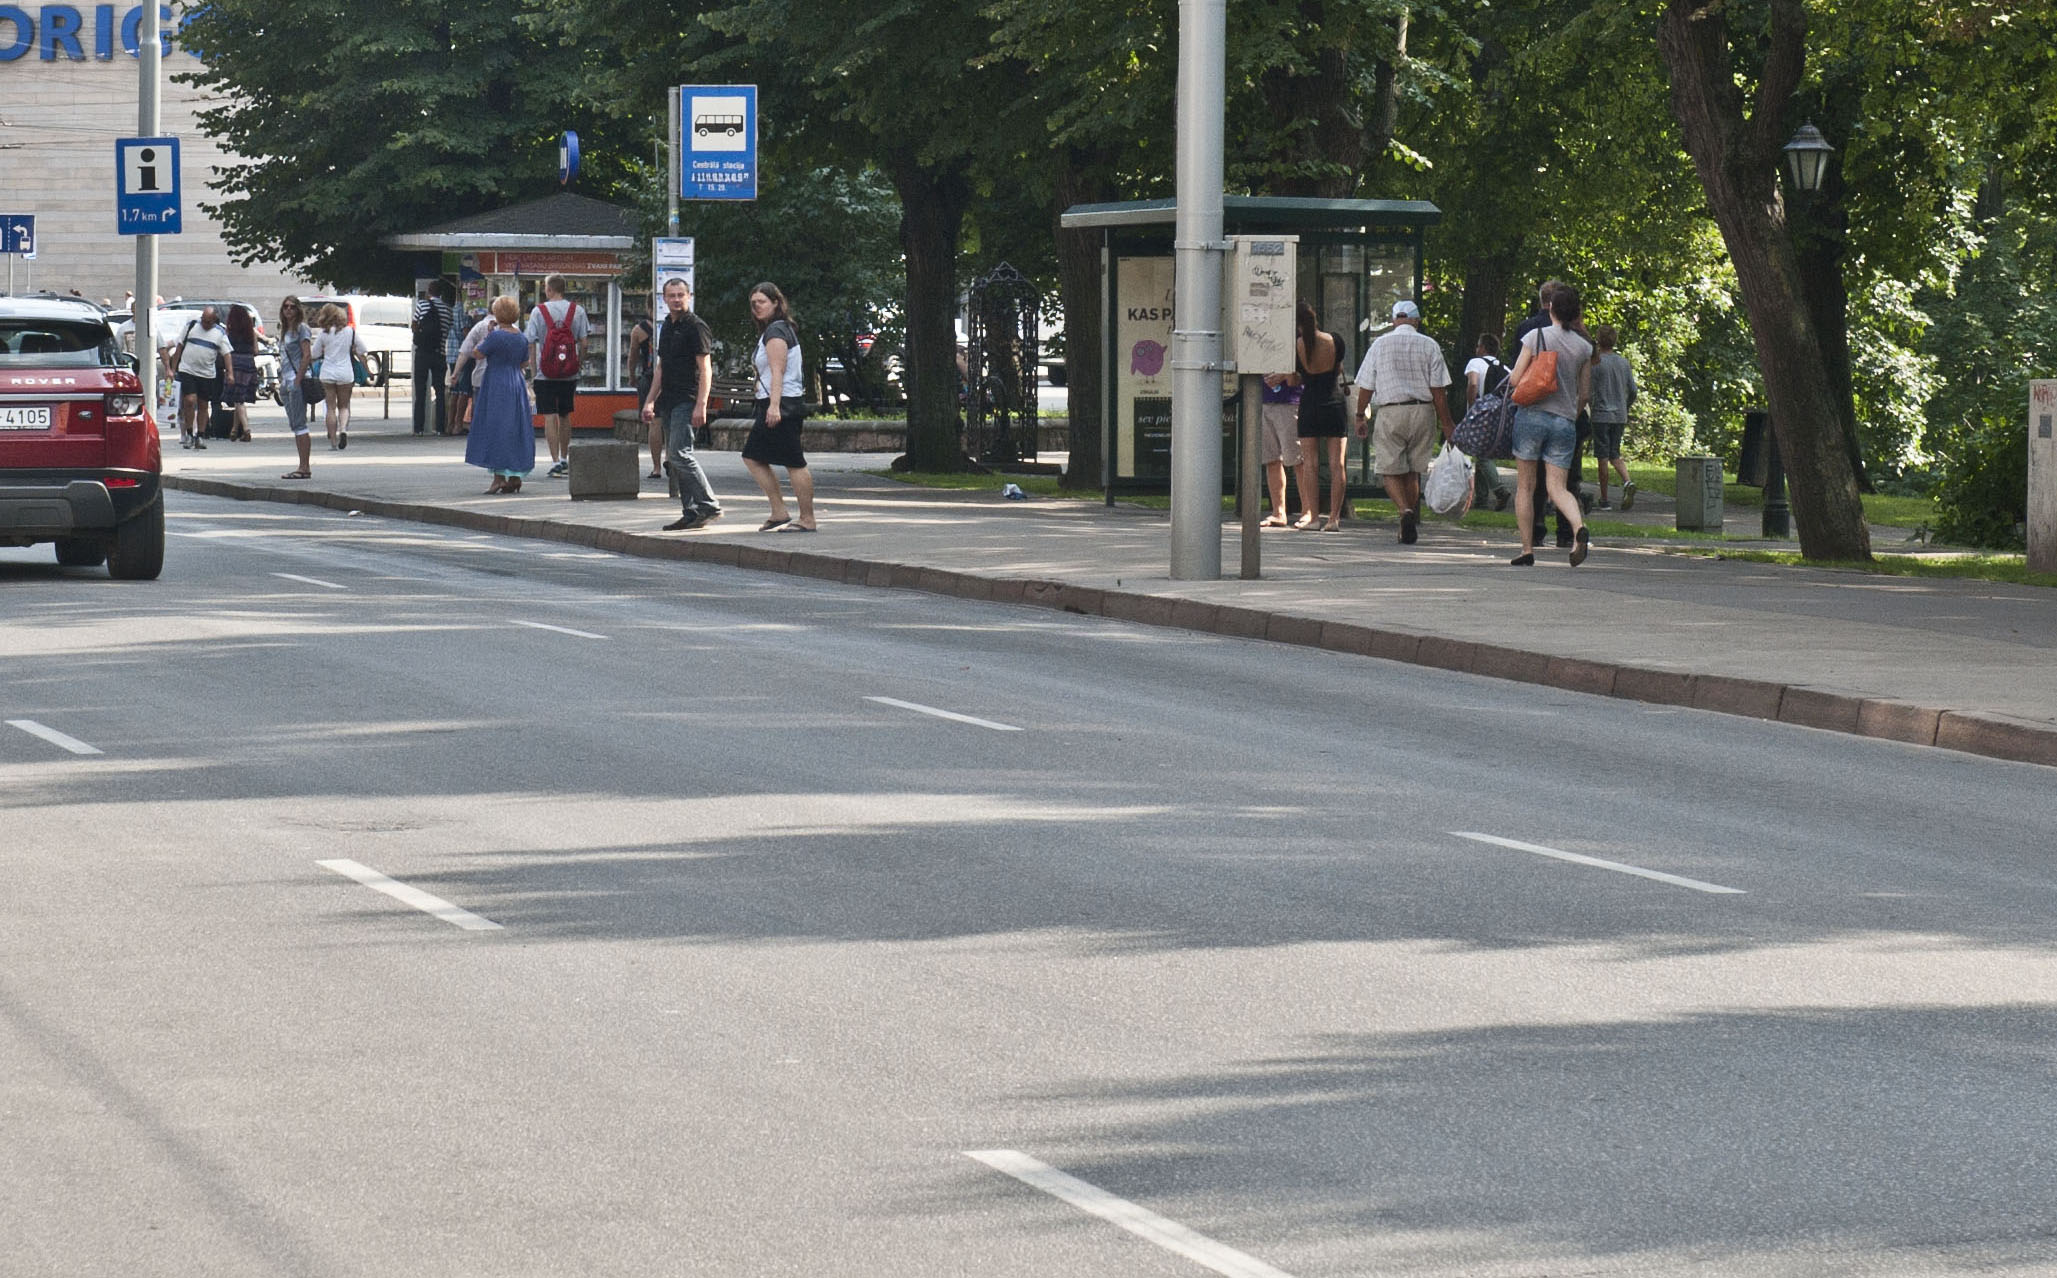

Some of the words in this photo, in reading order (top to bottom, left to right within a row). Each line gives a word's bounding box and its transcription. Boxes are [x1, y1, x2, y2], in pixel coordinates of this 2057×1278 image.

[141, 212, 157, 222] km
[1128, 307, 1159, 321] KAS
[11, 377, 76, 385] ROVER
